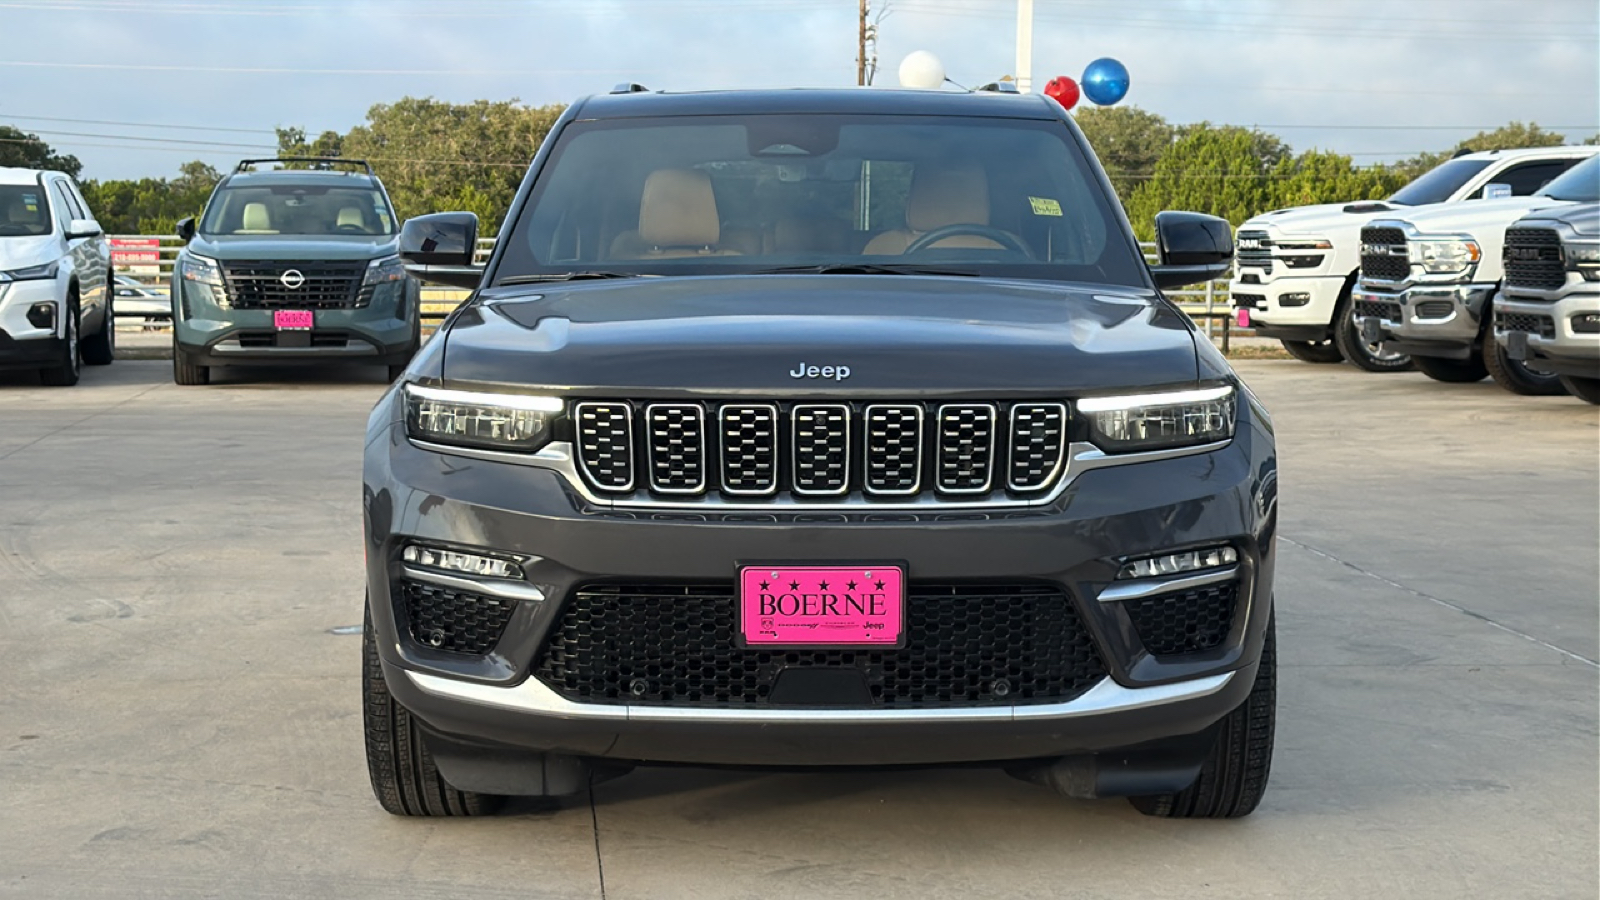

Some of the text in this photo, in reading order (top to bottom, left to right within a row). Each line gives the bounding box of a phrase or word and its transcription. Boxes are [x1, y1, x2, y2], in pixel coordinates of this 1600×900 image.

[1239, 239, 1259, 249] RAM
[789, 362, 851, 381] Jeep
[758, 593, 887, 616] BOERNE
[863, 621, 885, 630] Jeep
